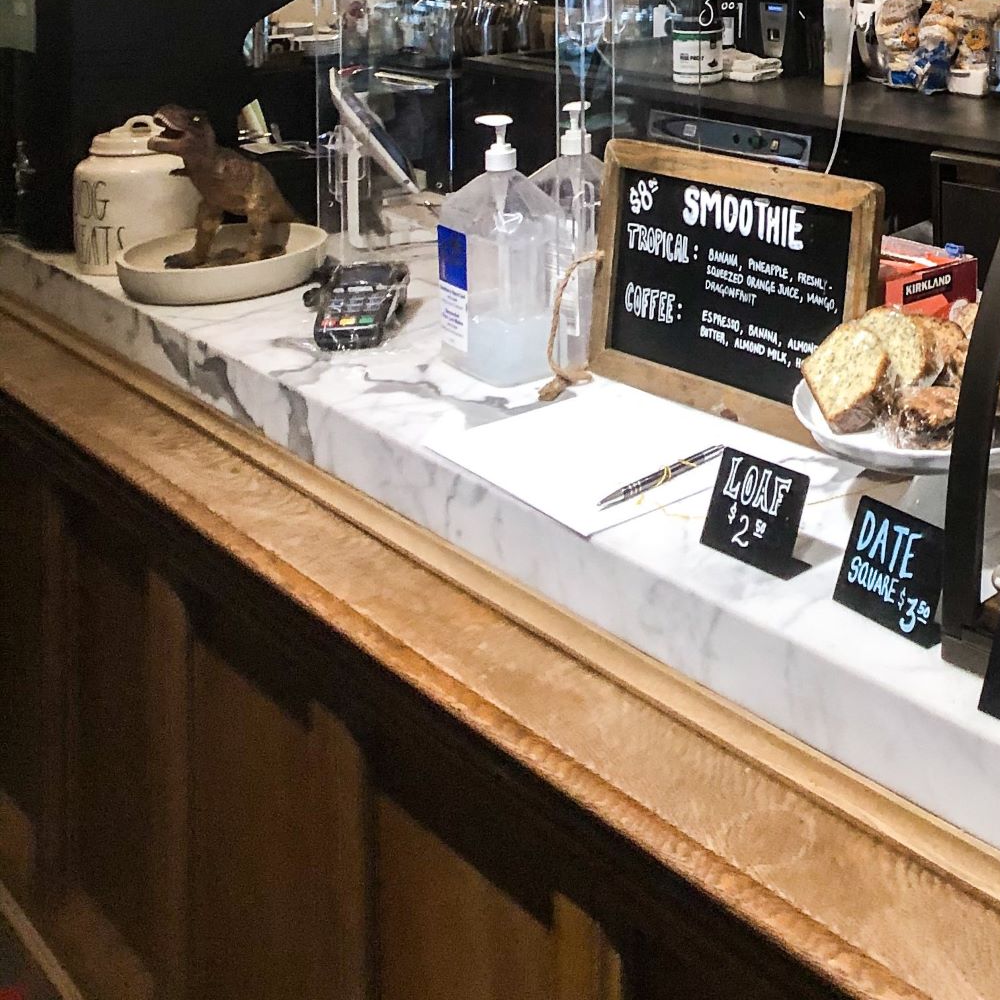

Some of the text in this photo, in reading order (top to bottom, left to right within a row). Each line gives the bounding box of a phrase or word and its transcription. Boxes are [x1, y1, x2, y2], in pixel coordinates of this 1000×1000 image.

[682, 185, 807, 251] SMOOTHIE
[705, 280, 758, 306] DRAGONFRUIT
[706, 264, 744, 285] SQUEEZED
[746, 275, 776, 295] ORANGE
[905, 274, 952, 296] KIRKLAND
[734, 338, 766, 356] ALMOND
[722, 456, 793, 517] LOAF
[856, 510, 923, 579] DATE
[847, 555, 899, 604] SQUARE
